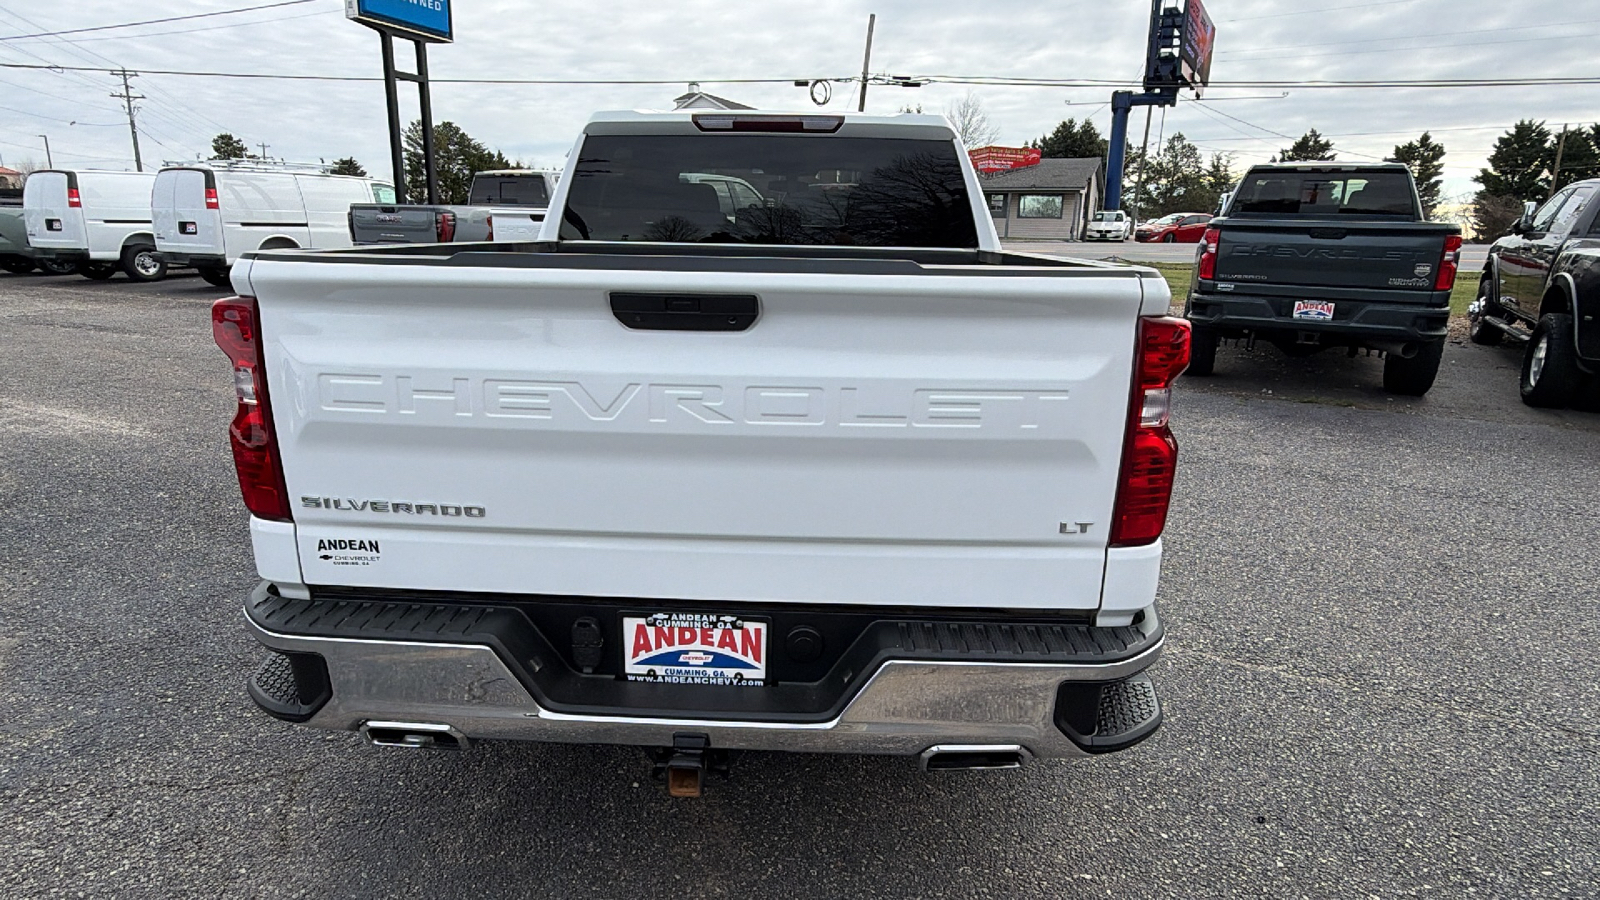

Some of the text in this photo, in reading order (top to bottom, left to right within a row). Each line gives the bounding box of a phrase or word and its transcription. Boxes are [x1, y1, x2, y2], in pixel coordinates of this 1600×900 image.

[1295, 302, 1333, 315] ANDEAN
[317, 372, 1070, 429] CHEVROLET
[301, 496, 486, 518] SILVERADO
[1059, 520, 1095, 534] LT
[317, 539, 380, 554] ANDEAN
[671, 613, 717, 623] ANDEAN
[717, 621, 733, 630] GA
[632, 623, 762, 665] ANDEAN
[664, 668, 729, 678] CUMMING, GA.
[627, 674, 764, 687] www.ANDEANCHEVY.com
